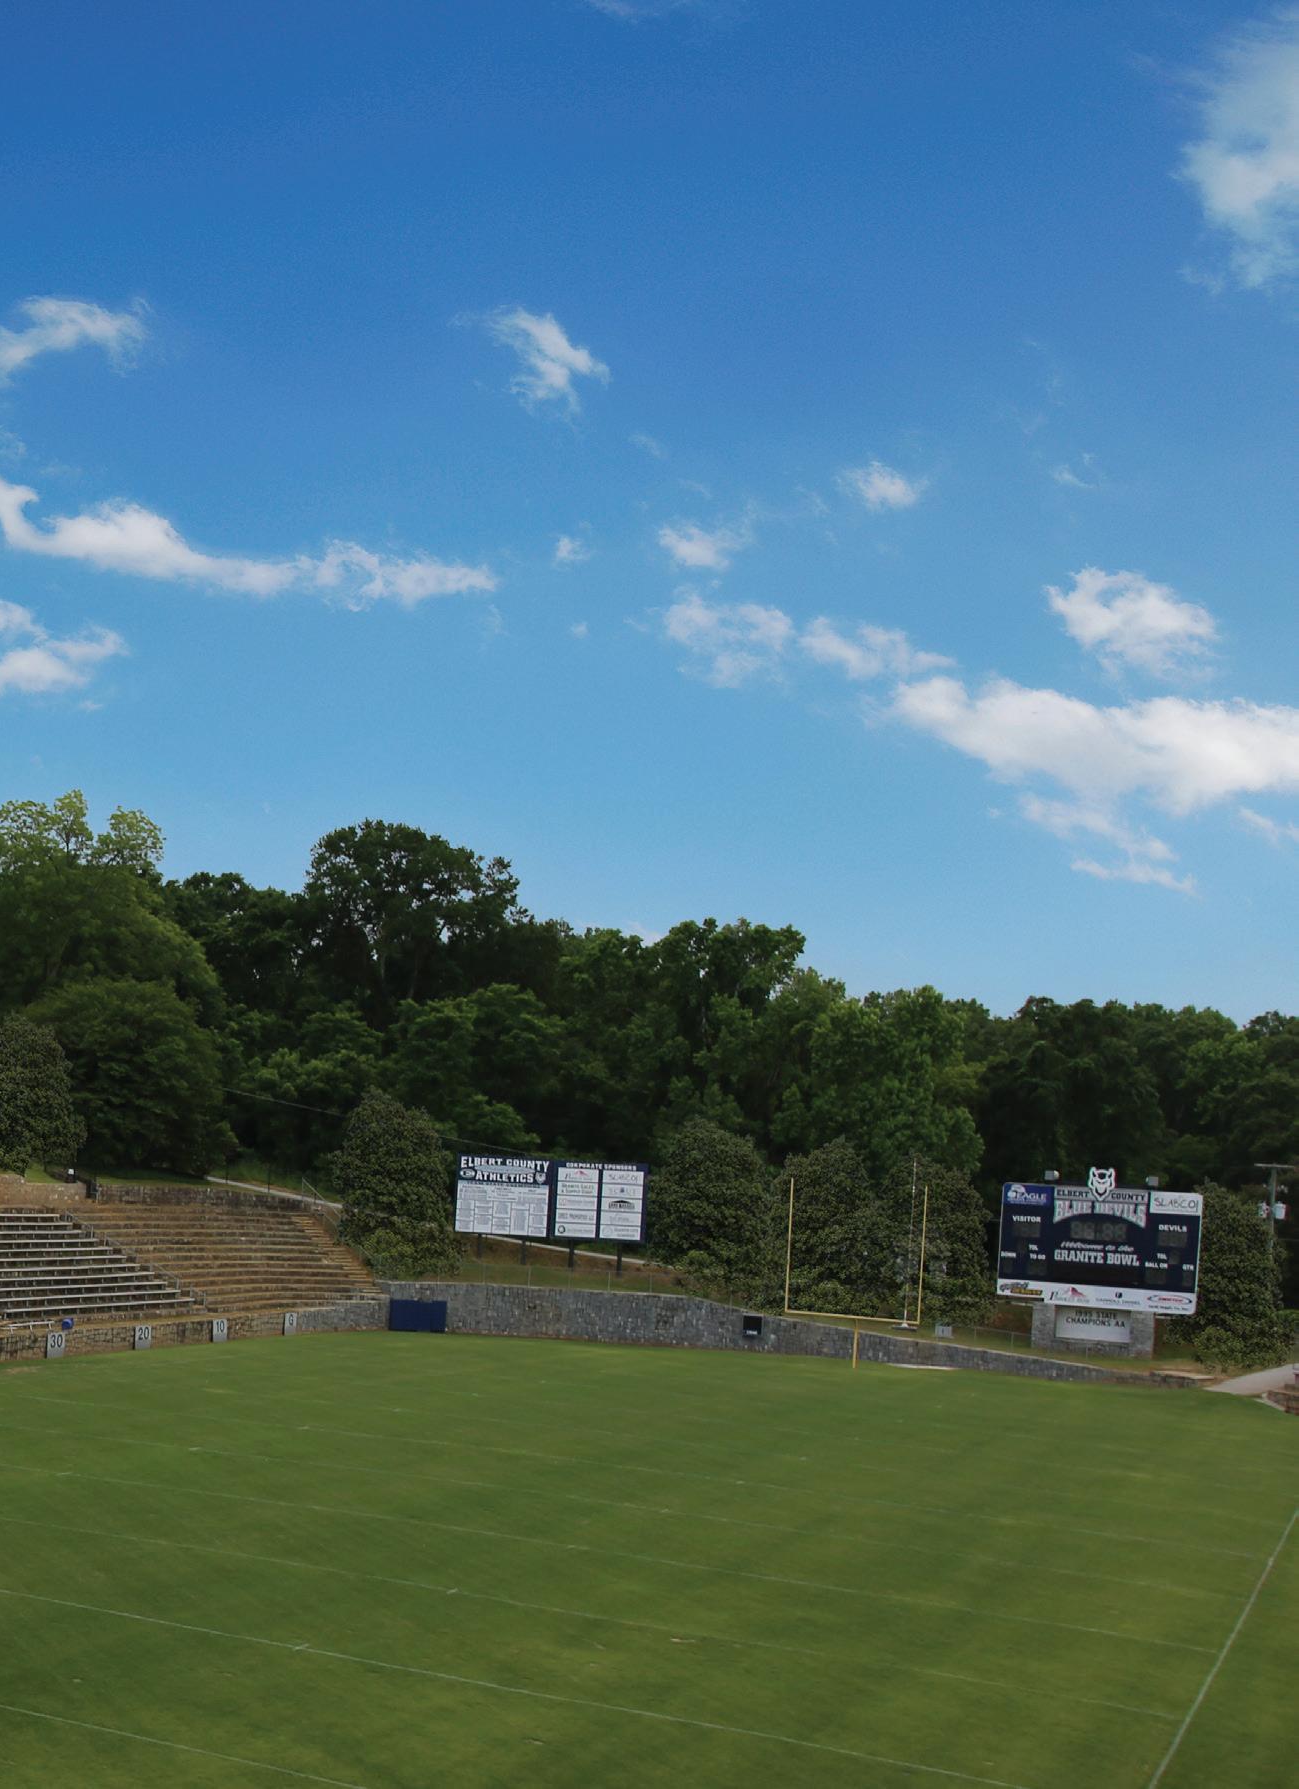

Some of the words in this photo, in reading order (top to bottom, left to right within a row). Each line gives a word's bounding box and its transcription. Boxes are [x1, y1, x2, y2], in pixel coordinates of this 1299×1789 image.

[461, 1156, 503, 1168] ELBERT
[506, 1158, 550, 1173] COUNTY
[566, 1162, 602, 1170] CORPORATE
[475, 1170, 534, 1183] ATHLETICS
[1017, 1191, 1047, 1200] EAGLE
[1056, 1189, 1090, 1198] ELBERT
[1111, 1192, 1145, 1201] COUNTY
[1012, 1215, 1041, 1223] VISITOR
[1053, 1199, 1093, 1224] BLUE
[1094, 1201, 1146, 1228] DEVILS
[1158, 1224, 1187, 1232] DEVILS
[1054, 1249, 1104, 1264] GRANITE
[1106, 1252, 1140, 1267] BOWL
[288, 1313, 295, 1326] G
[1066, 1316, 1110, 1327] CHAMPIONS
[1115, 1320, 1126, 1328] AA
[1096, 1311, 1118, 1320] STATE
[214, 1320, 225, 1334] 10
[137, 1327, 150, 1342] 20
[50, 1334, 63, 1349] 30
